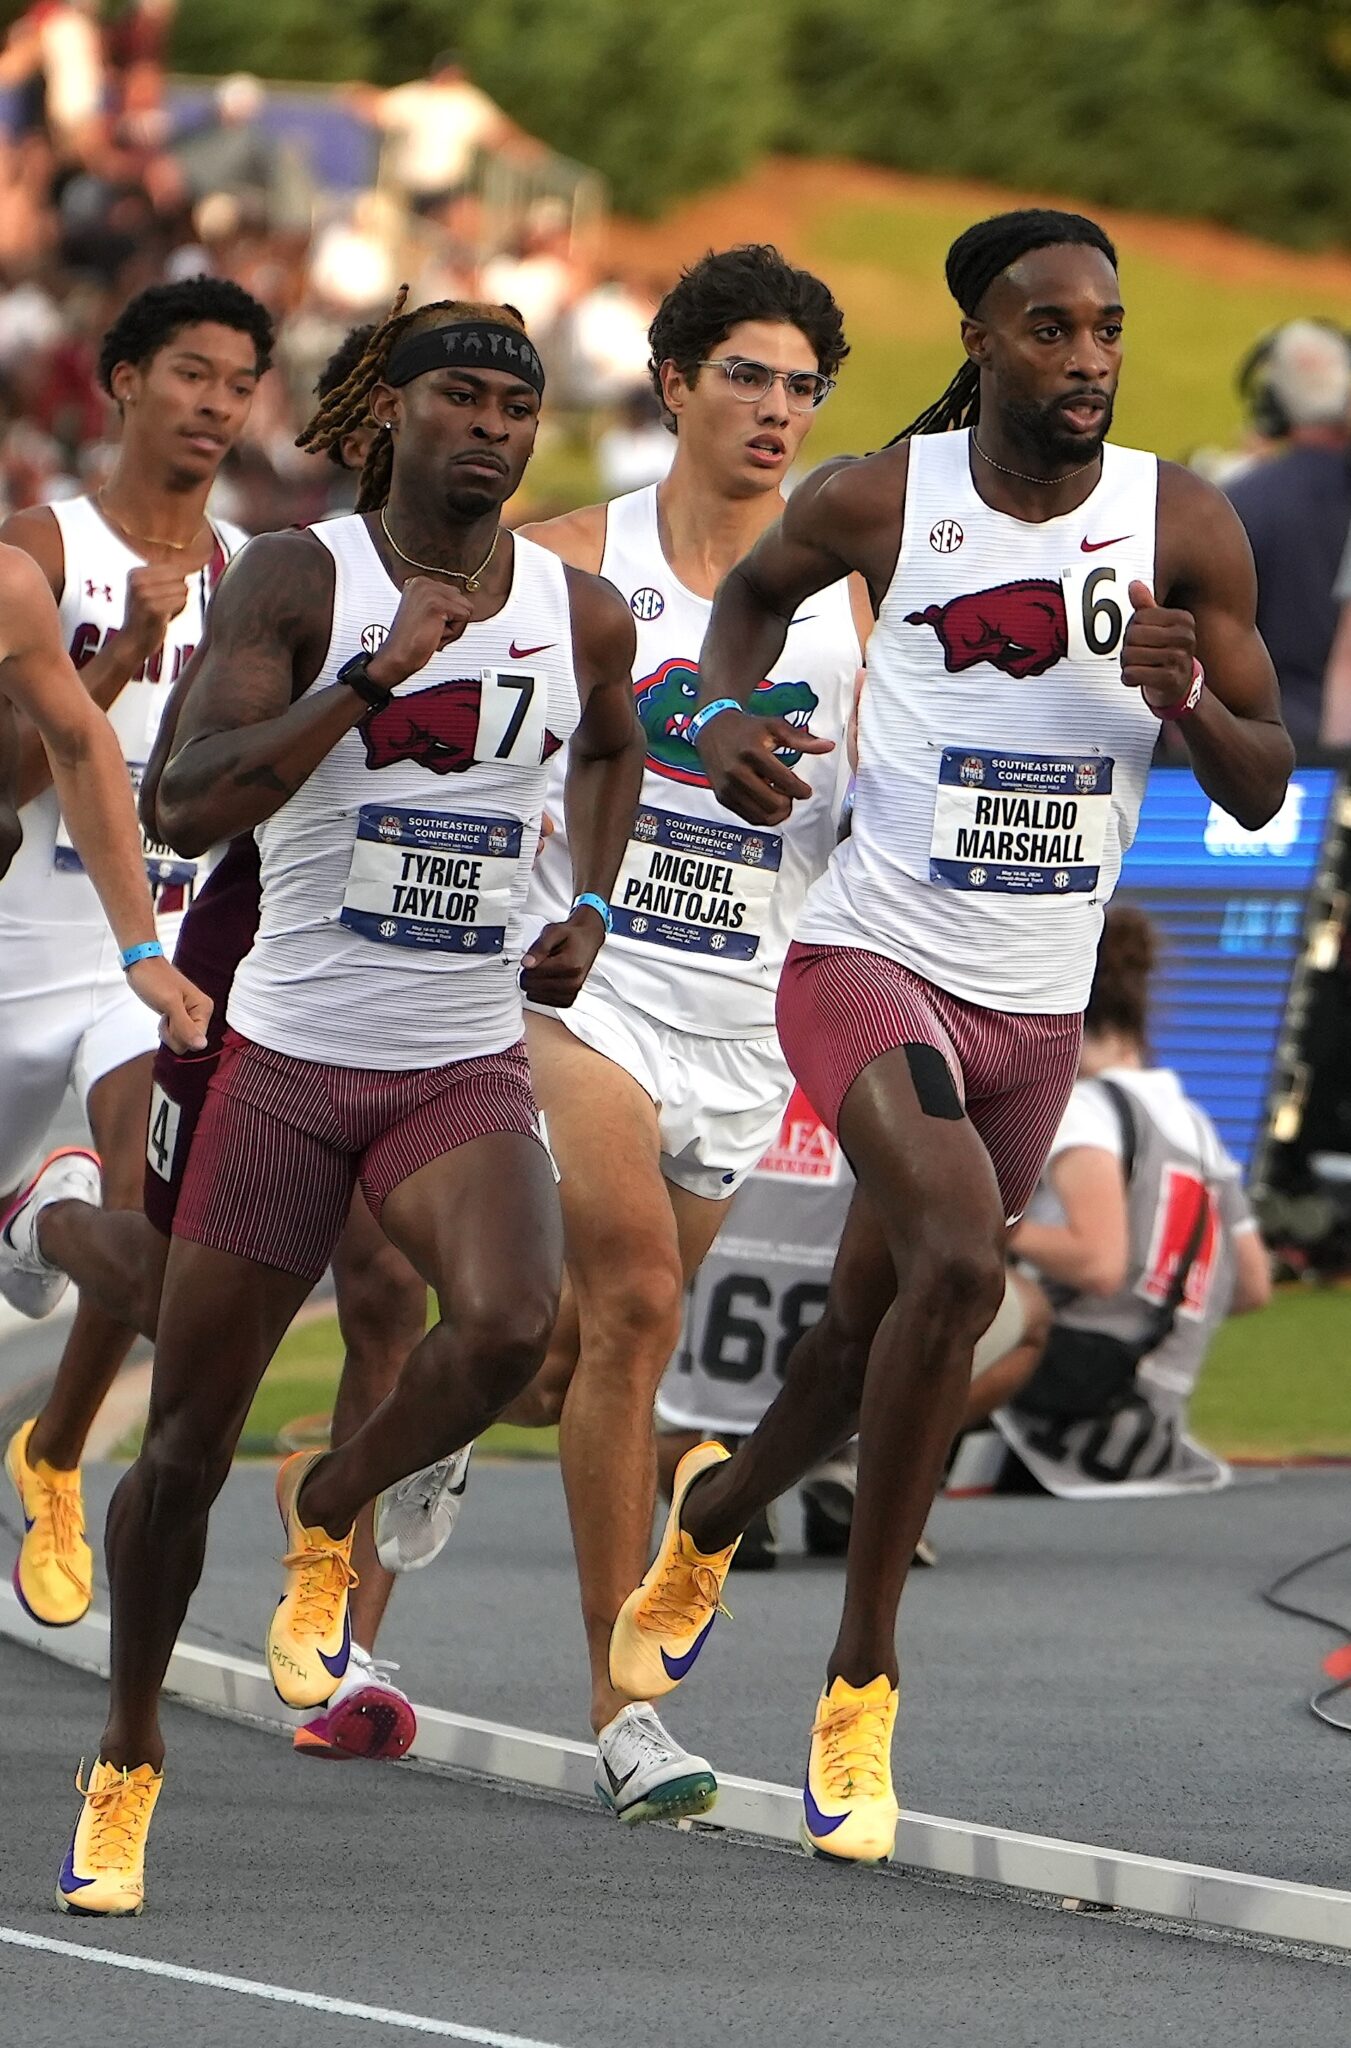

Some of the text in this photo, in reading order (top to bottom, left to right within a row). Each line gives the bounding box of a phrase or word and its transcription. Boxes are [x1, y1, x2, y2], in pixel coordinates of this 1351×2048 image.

[441, 331, 541, 376] TAYLOR
[931, 520, 963, 552] SEC
[632, 589, 664, 620] SEC
[1082, 567, 1122, 655] 6
[494, 673, 535, 759] 7
[991, 759, 1075, 773] SOUTHEASTERN
[997, 772, 1067, 784] CONFERENCE
[408, 817, 488, 834] SOUTHEASTERN
[975, 796, 1078, 830] RIVALDO
[414, 828, 480, 844] CONFERENCE
[665, 818, 743, 842] SOUTHEASTERN
[669, 830, 733, 851] CONFERENCE
[956, 828, 1085, 863] MARSHALL
[401, 853, 482, 890] TYRICE
[648, 851, 734, 895] MIGUEL
[969, 868, 987, 885] SEC
[1054, 872, 1070, 888] SEC
[392, 885, 479, 922] TAYLOR
[623, 878, 746, 928] PANTOJAS
[380, 920, 397, 937] SEC
[463, 932, 477, 947] SEC
[631, 917, 648, 933] SEC
[711, 934, 727, 949] SEC
[152, 1099, 169, 1173] 4
[272, 1645, 308, 1682] FAITH
